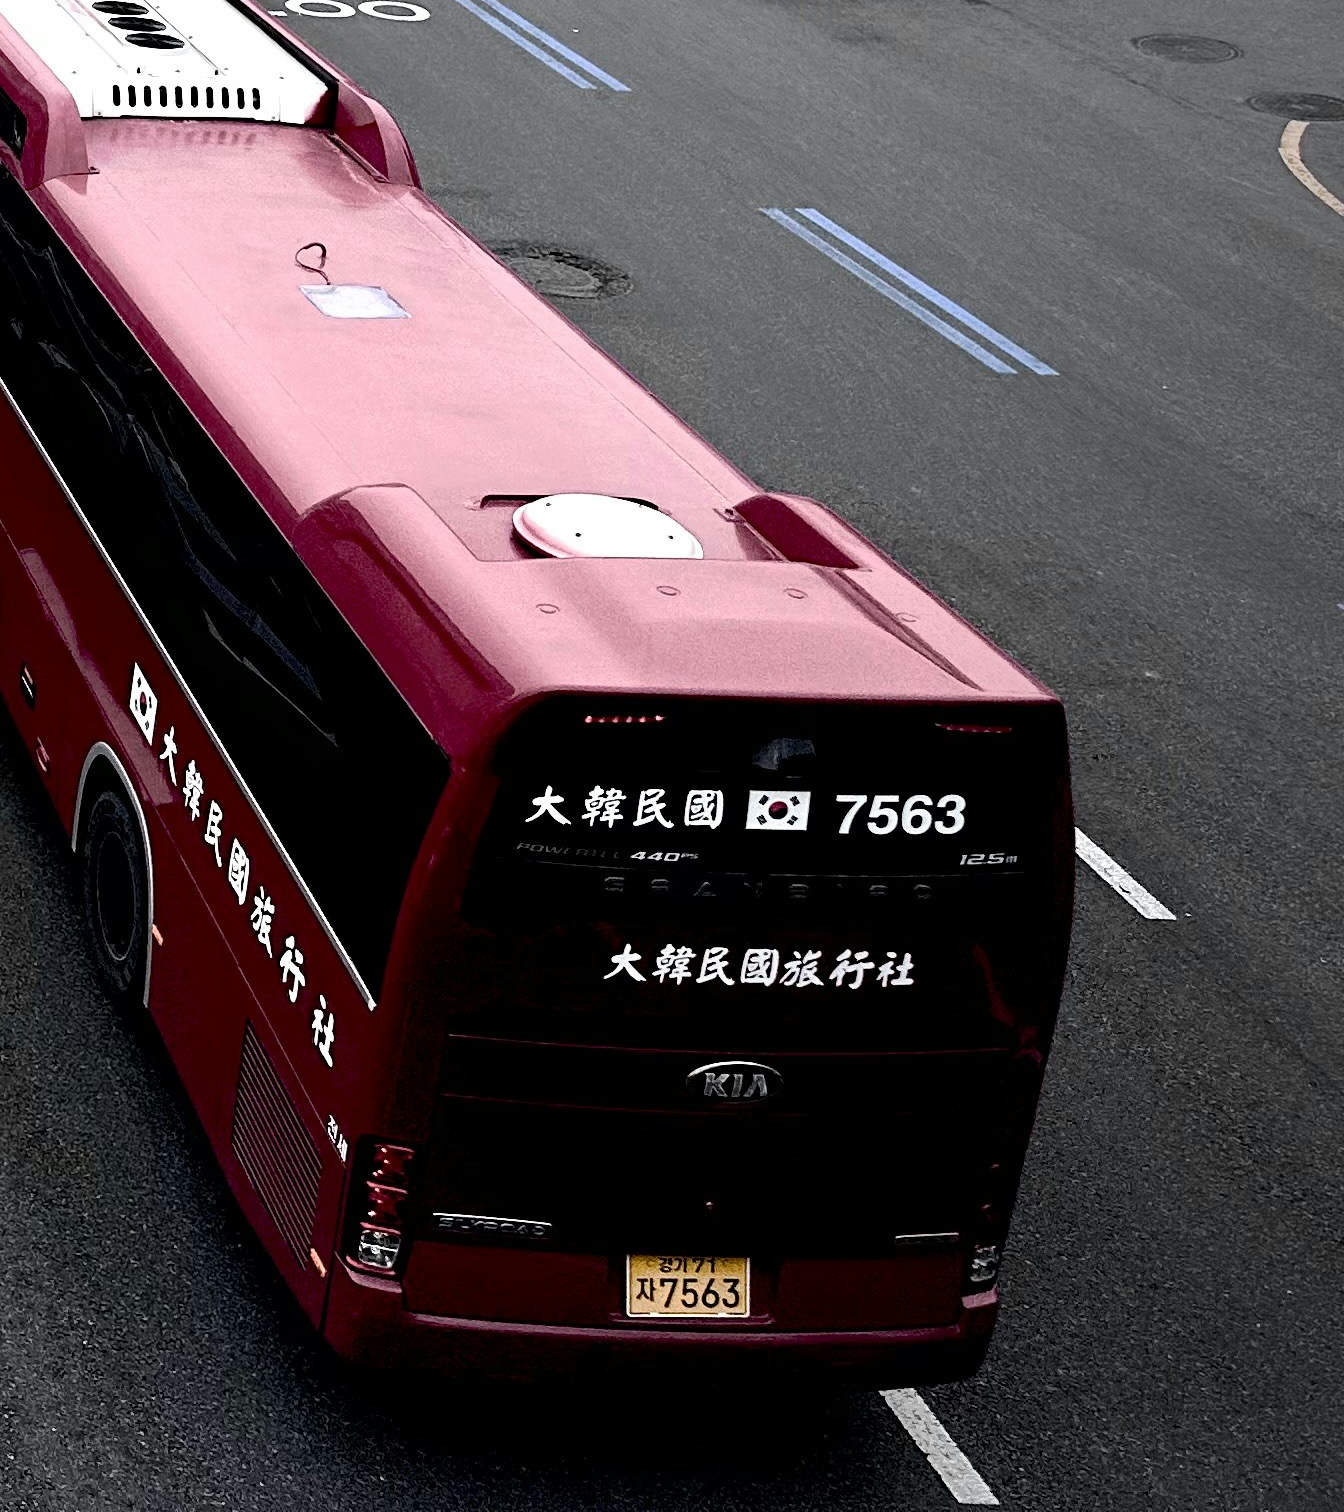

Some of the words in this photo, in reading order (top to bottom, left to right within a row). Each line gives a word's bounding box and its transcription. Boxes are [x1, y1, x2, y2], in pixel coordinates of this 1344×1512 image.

[525, 785, 725, 830] 大韓民國
[835, 794, 967, 835] 7563
[159, 725, 335, 1068] 大韓民國旅行社
[603, 943, 915, 989] 大韓民國旅行社
[703, 1071, 770, 1099] KIA
[635, 1277, 740, 1309] 자7563
